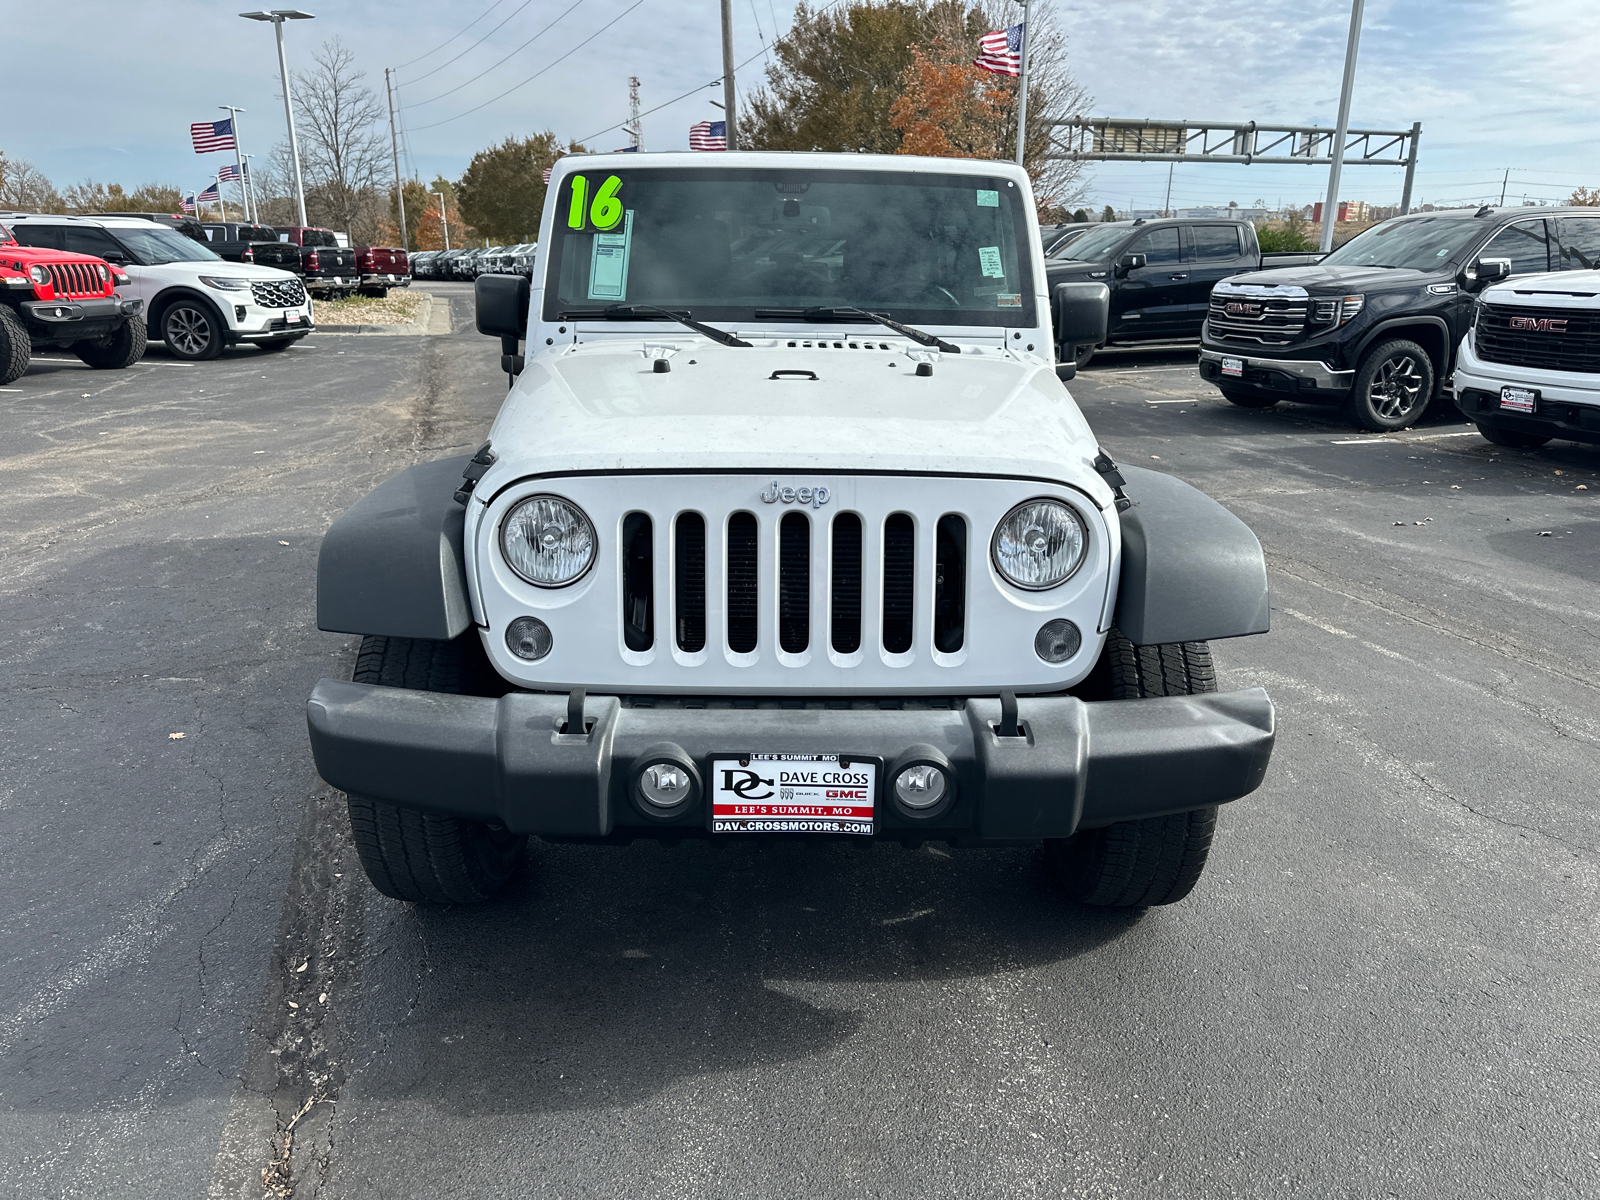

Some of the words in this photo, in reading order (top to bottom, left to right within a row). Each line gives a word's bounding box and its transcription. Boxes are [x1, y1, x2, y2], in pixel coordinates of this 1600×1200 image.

[567, 174, 624, 231] 16
[1226, 302, 1261, 314] GMC
[1509, 316, 1568, 332] GMC
[760, 480, 831, 509] Jeep
[779, 771, 818, 783] DAVE
[822, 772, 869, 785] CROSS
[825, 790, 867, 798] GMC
[734, 805, 768, 814] LEE'S
[771, 806, 827, 816] SUMMIT,
[832, 807, 853, 815] MO
